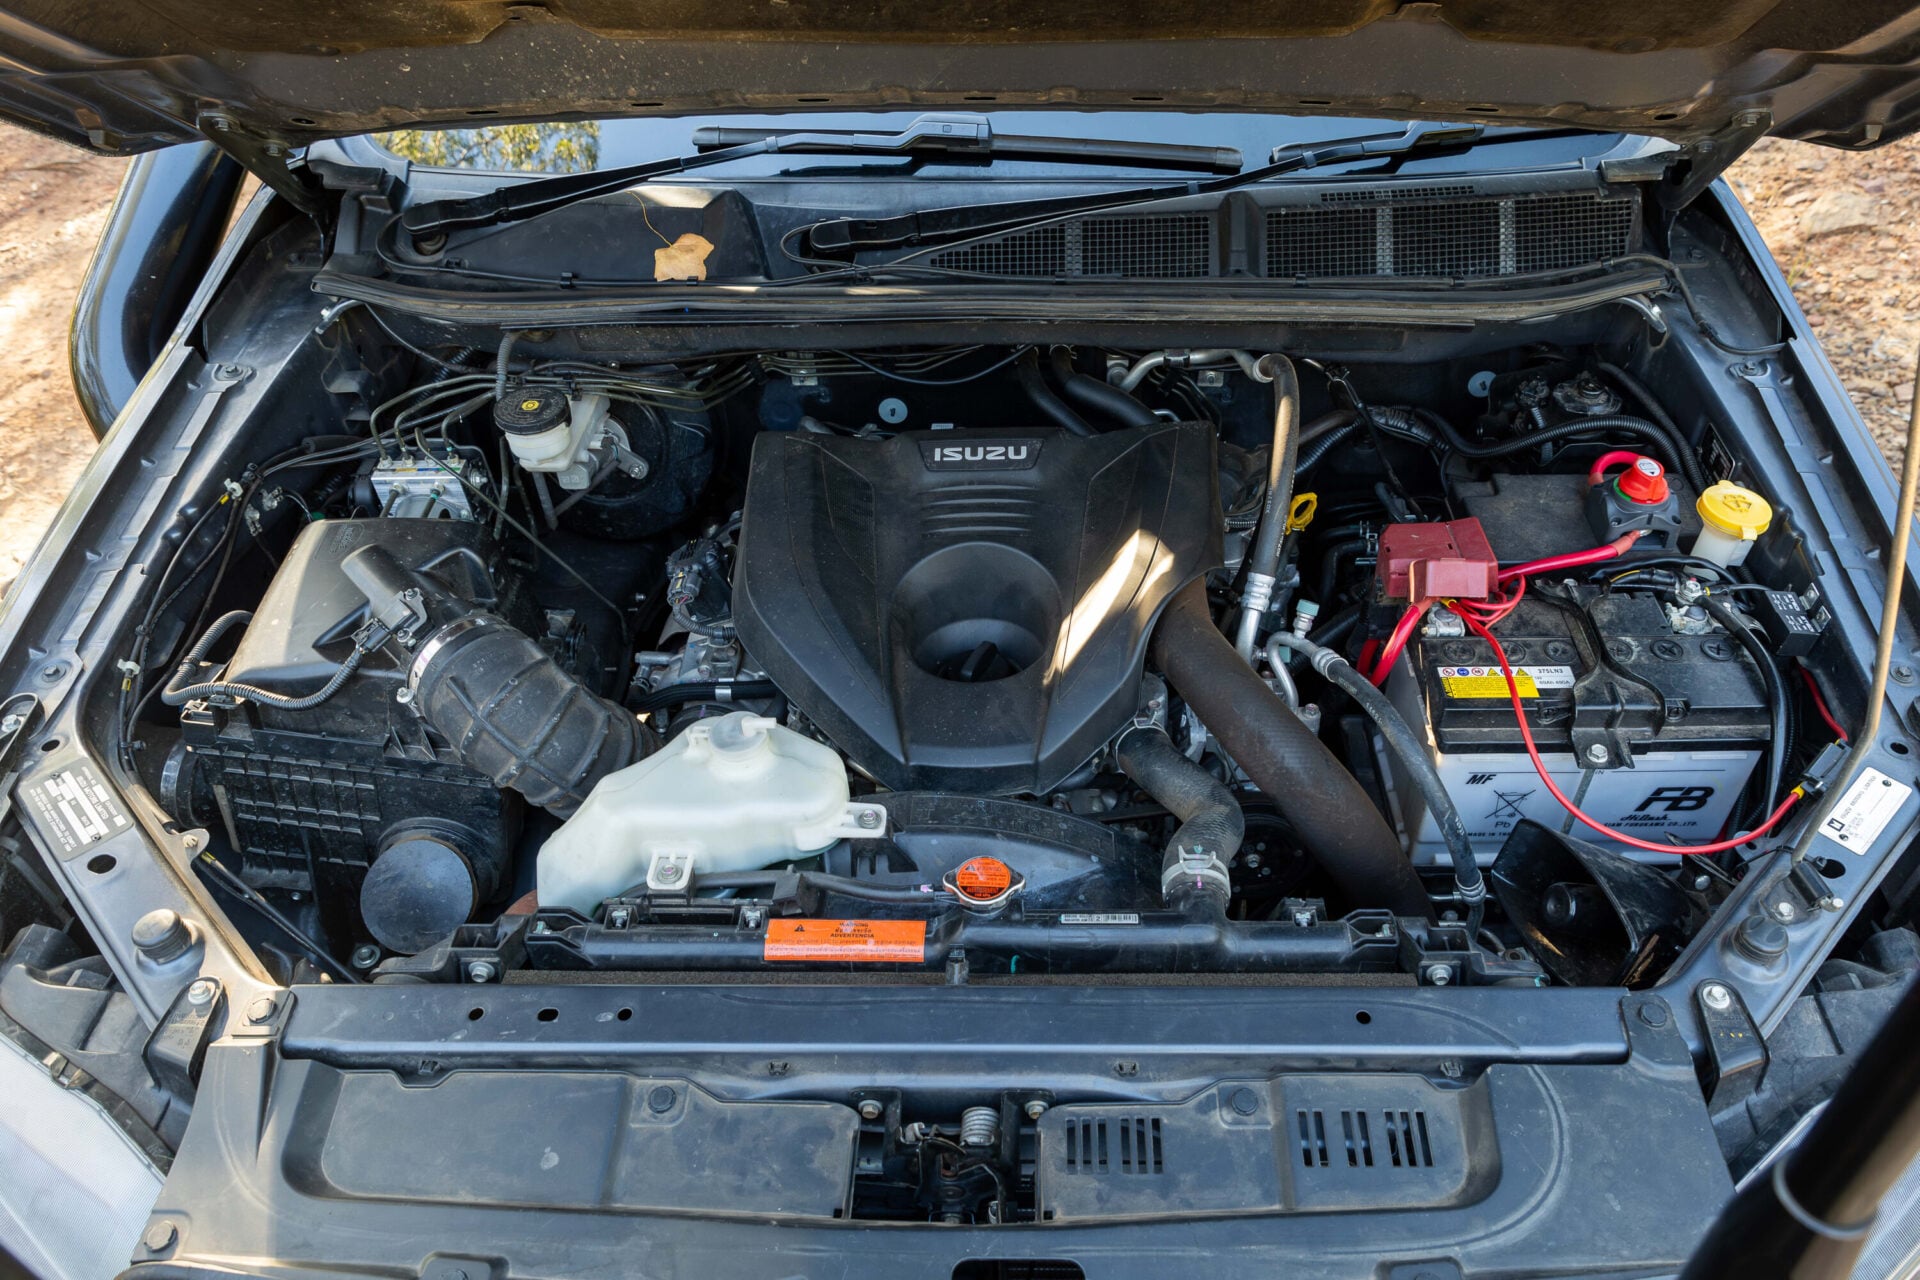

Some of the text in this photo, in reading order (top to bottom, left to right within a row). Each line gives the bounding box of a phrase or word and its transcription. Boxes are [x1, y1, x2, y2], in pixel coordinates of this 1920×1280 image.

[934, 446, 1027, 461] ISUZU
[1466, 774, 1496, 784] MF
[1634, 786, 1714, 811] FB
